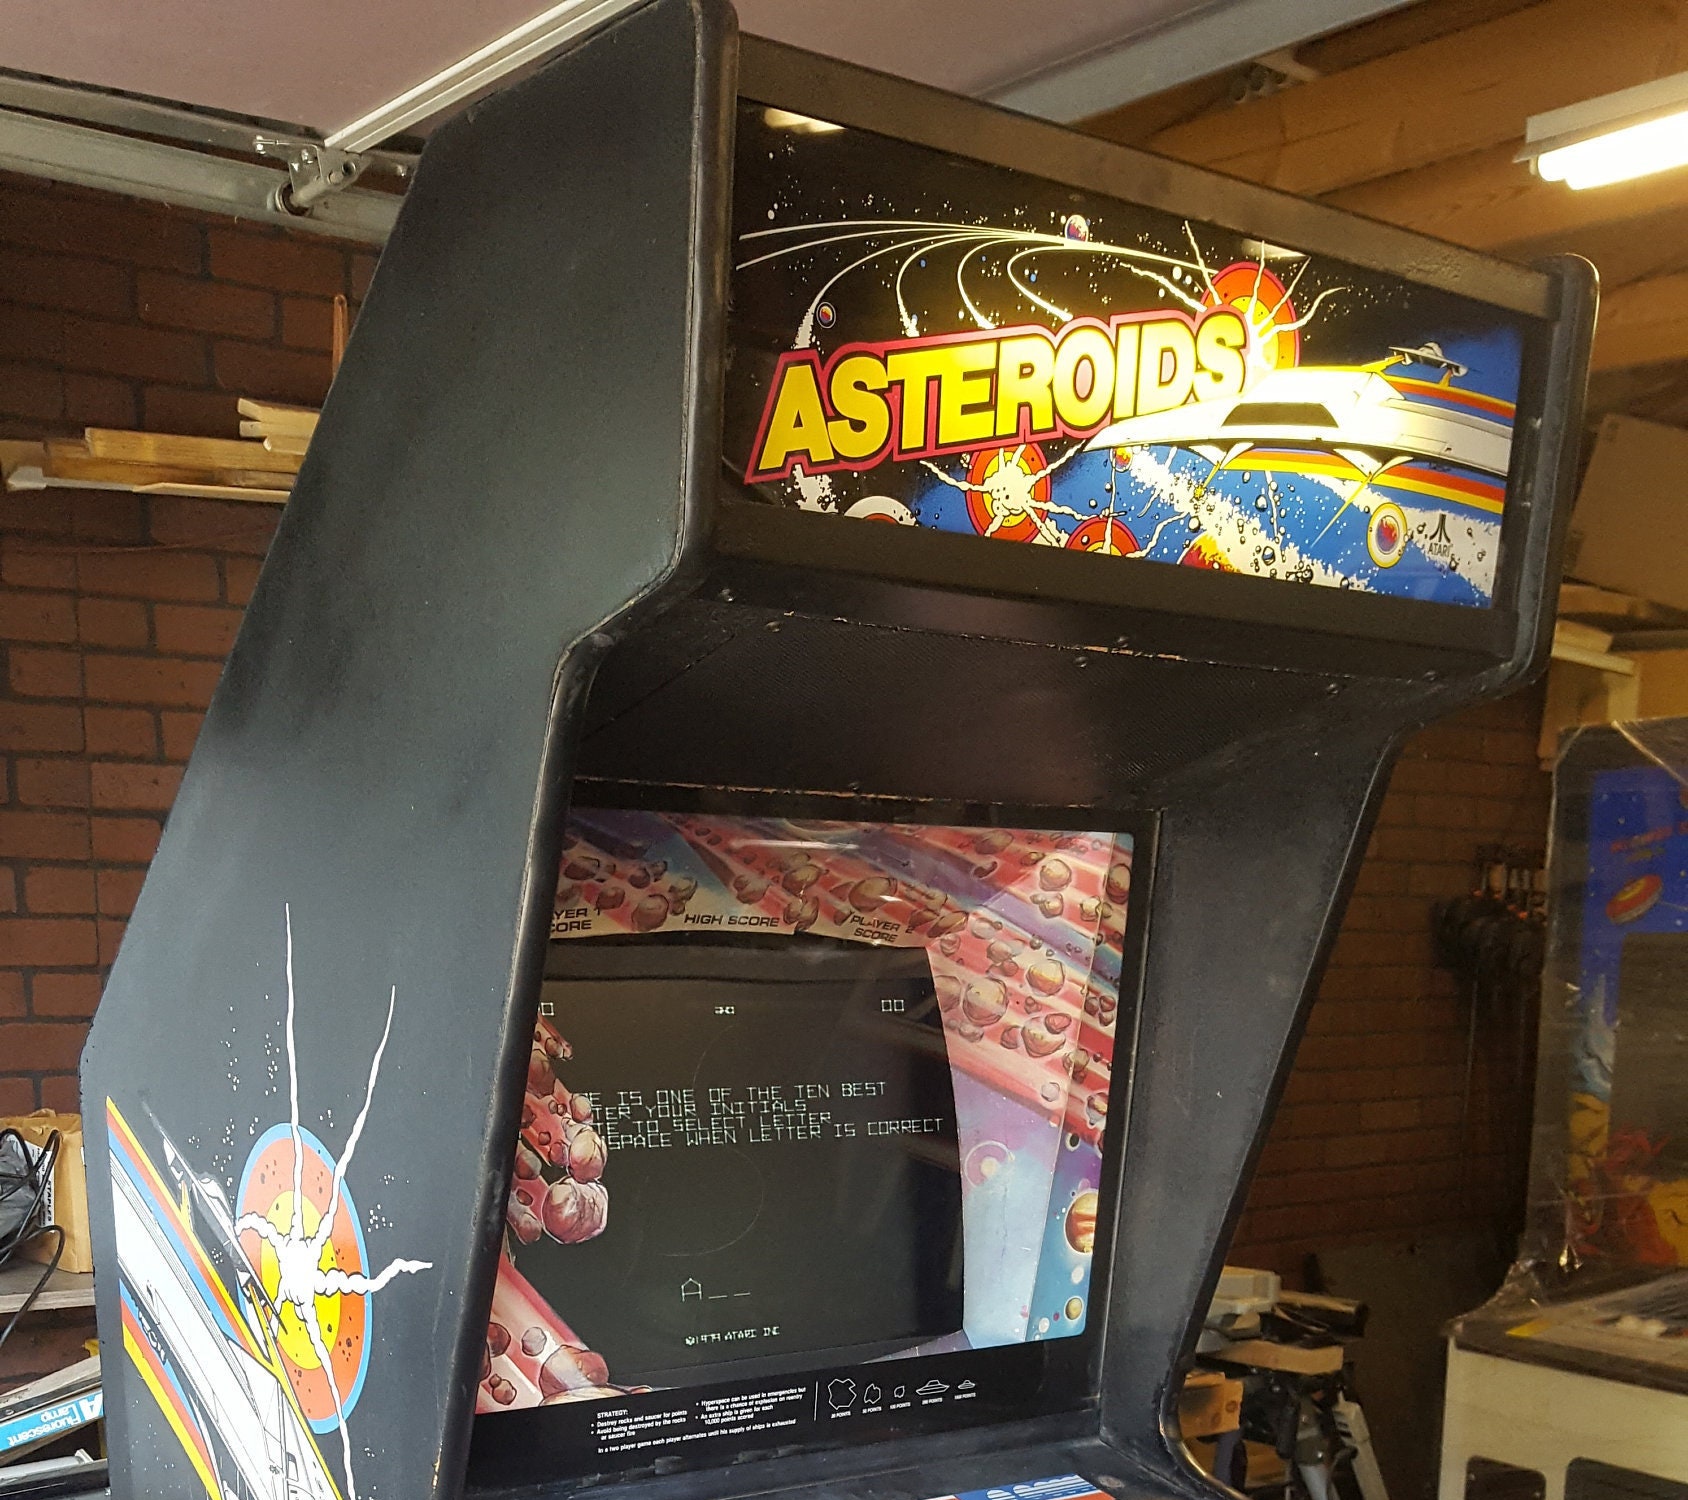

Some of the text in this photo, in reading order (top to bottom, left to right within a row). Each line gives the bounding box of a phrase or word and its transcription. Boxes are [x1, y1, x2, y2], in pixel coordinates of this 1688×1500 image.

[756, 311, 1247, 474] ASTEROIDS
[1428, 542, 1451, 558] ATARI
[683, 913, 780, 927] HIGH SCORE
[850, 914, 901, 932] PLAYER
[853, 927, 898, 943] SCORE
[617, 1090, 643, 1106] IS
[656, 1088, 694, 1105] ONE
[708, 1087, 732, 1103] OF
[746, 1086, 782, 1100] THE
[794, 1084, 830, 1099] TEN
[841, 1081, 886, 1097] BEST
[645, 1103, 697, 1118] YOUR
[710, 1099, 807, 1116] INITIALS
[632, 1120, 659, 1134] TO
[672, 1116, 746, 1132] SELECT
[760, 1112, 831, 1128] LETTER
[605, 1118, 944, 1150] SPACE WHEN LETTER IS CORRECT
[7, 1415, 81, 1447] Fluorescent
